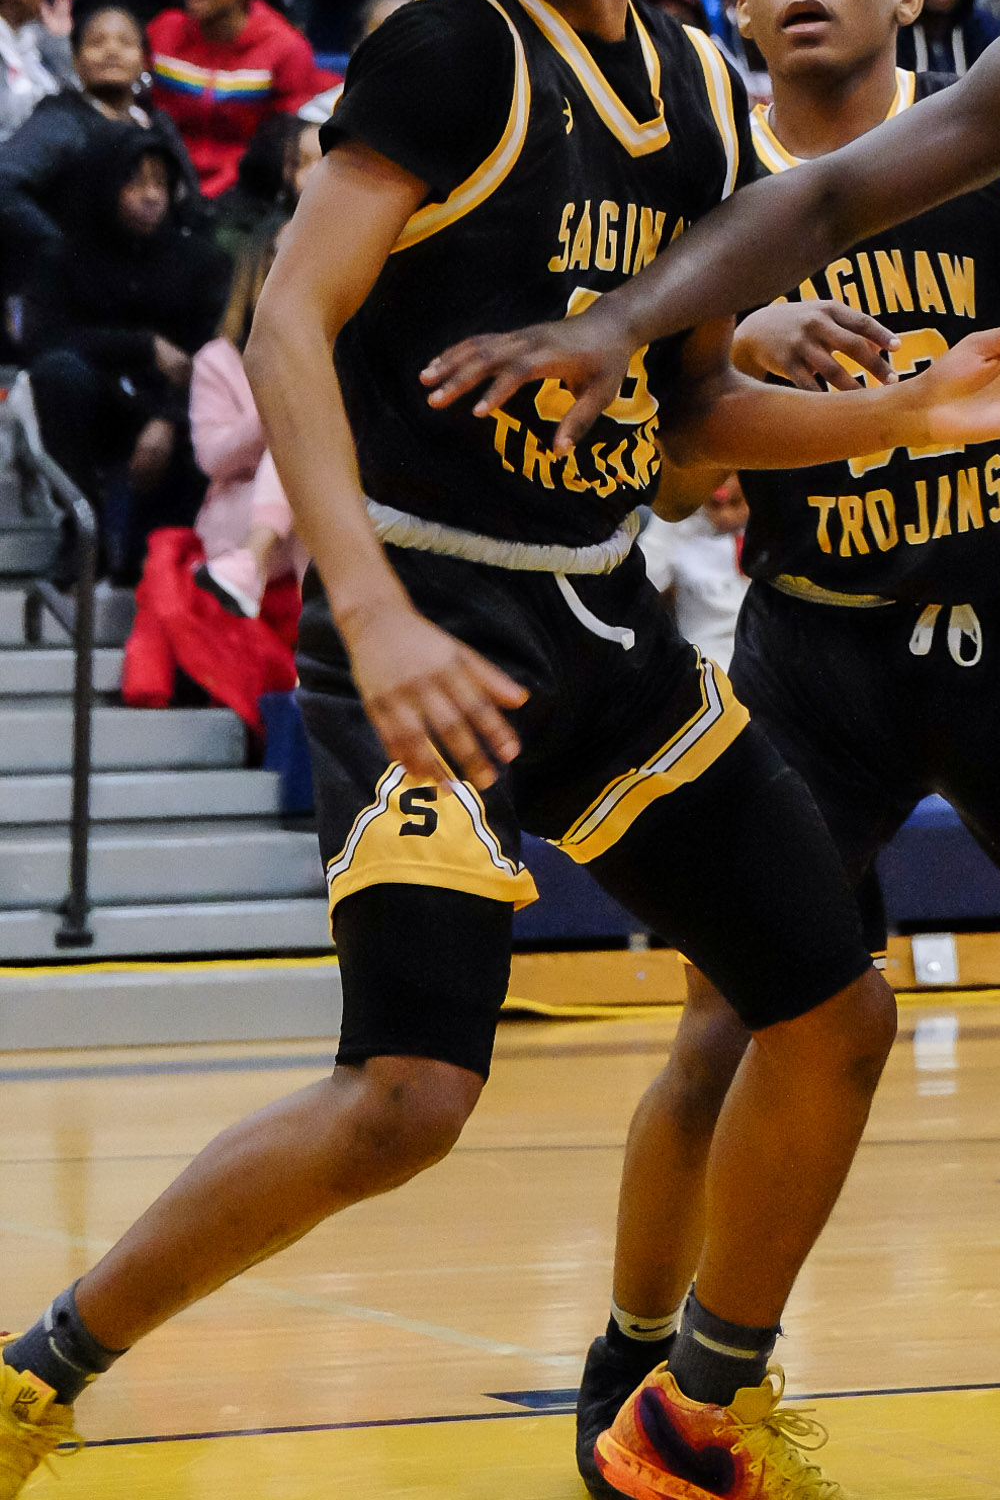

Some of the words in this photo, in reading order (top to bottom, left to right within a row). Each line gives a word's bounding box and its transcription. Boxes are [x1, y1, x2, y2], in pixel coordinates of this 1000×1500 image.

[548, 200, 692, 276] SAGIN
[773, 249, 976, 318] GINAW
[399, 786, 438, 837] S
